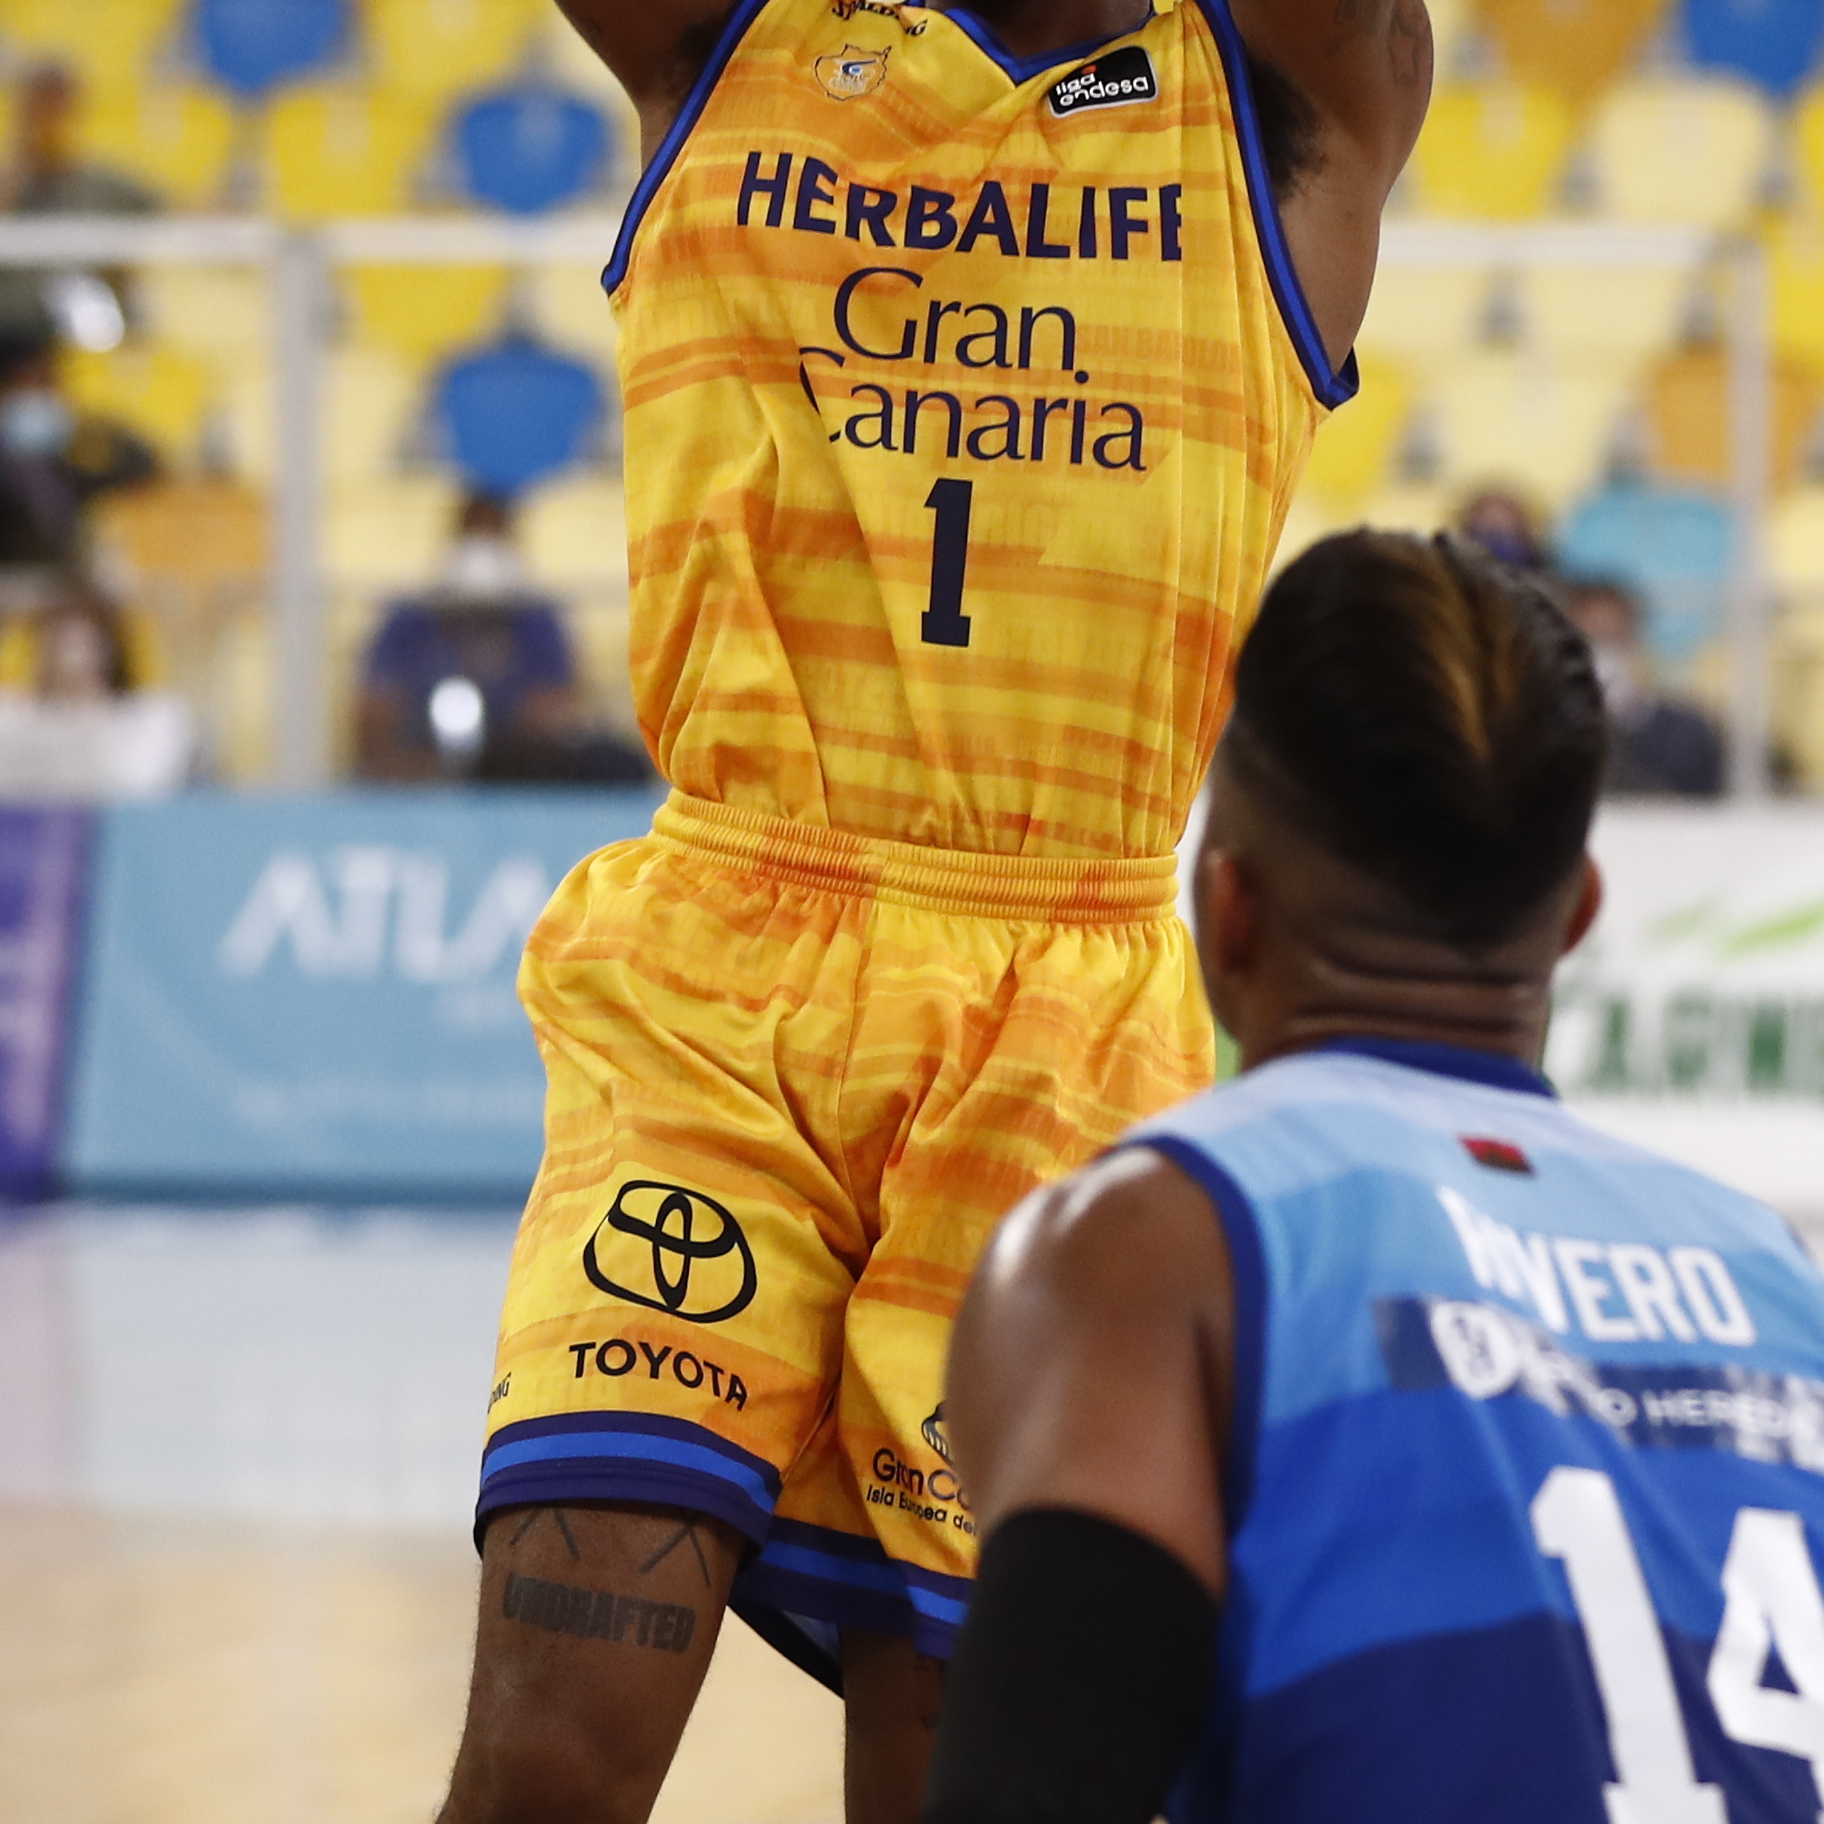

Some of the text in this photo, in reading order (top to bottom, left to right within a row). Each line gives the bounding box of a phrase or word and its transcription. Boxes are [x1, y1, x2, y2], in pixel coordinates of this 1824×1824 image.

[1056, 73, 1096, 96] liga
[1060, 76, 1149, 106] endesa
[833, 267, 1077, 371] Gran
[920, 477, 973, 648] 1
[569, 1338, 749, 1411] TOYOTA
[867, 1484, 894, 1507] Isla
